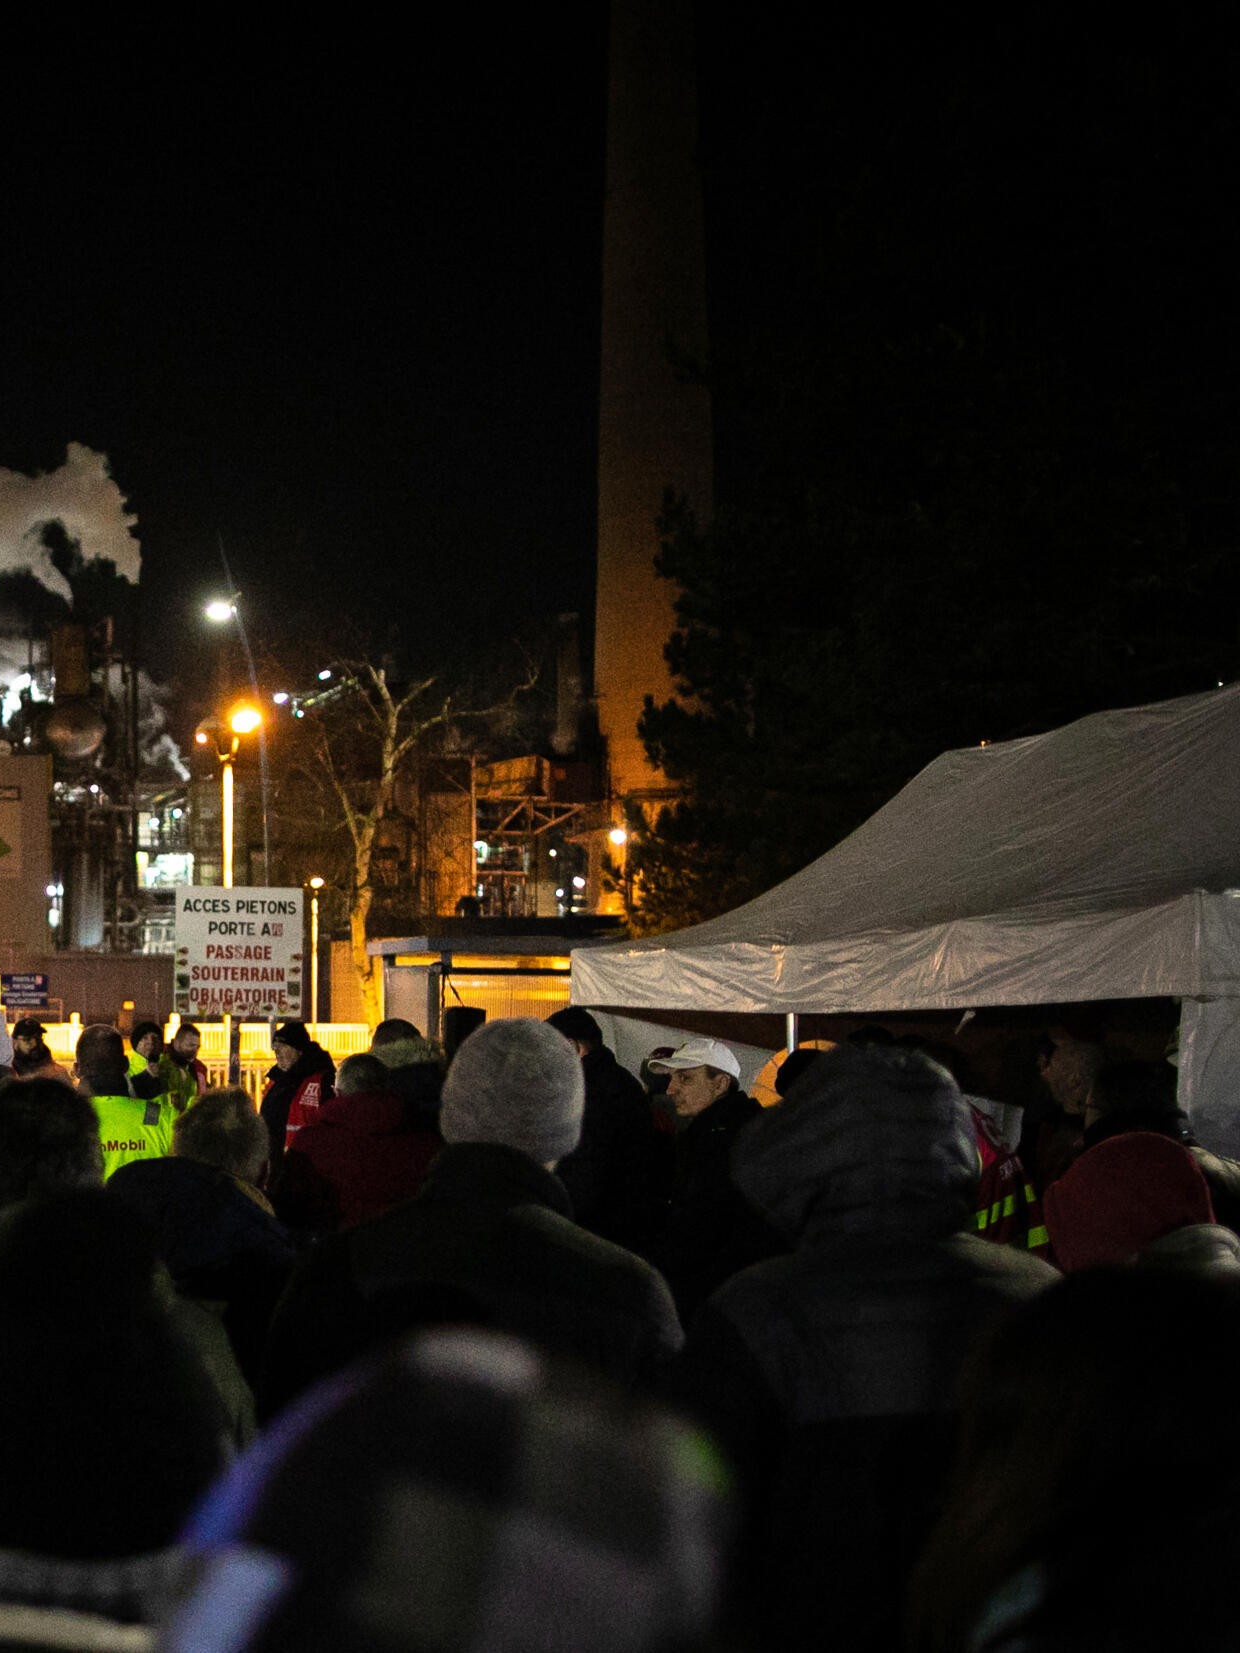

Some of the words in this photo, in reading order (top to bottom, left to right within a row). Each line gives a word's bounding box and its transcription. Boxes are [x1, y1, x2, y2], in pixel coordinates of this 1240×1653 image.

[183, 898, 231, 913] ACCES
[235, 899, 297, 915] PIETONS
[208, 921, 255, 936] PORTE
[261, 922, 272, 937] A
[206, 945, 272, 960] PASSAGE
[191, 965, 285, 982] SOUTERRAIN
[190, 987, 286, 1004] OBLIGATOIRE
